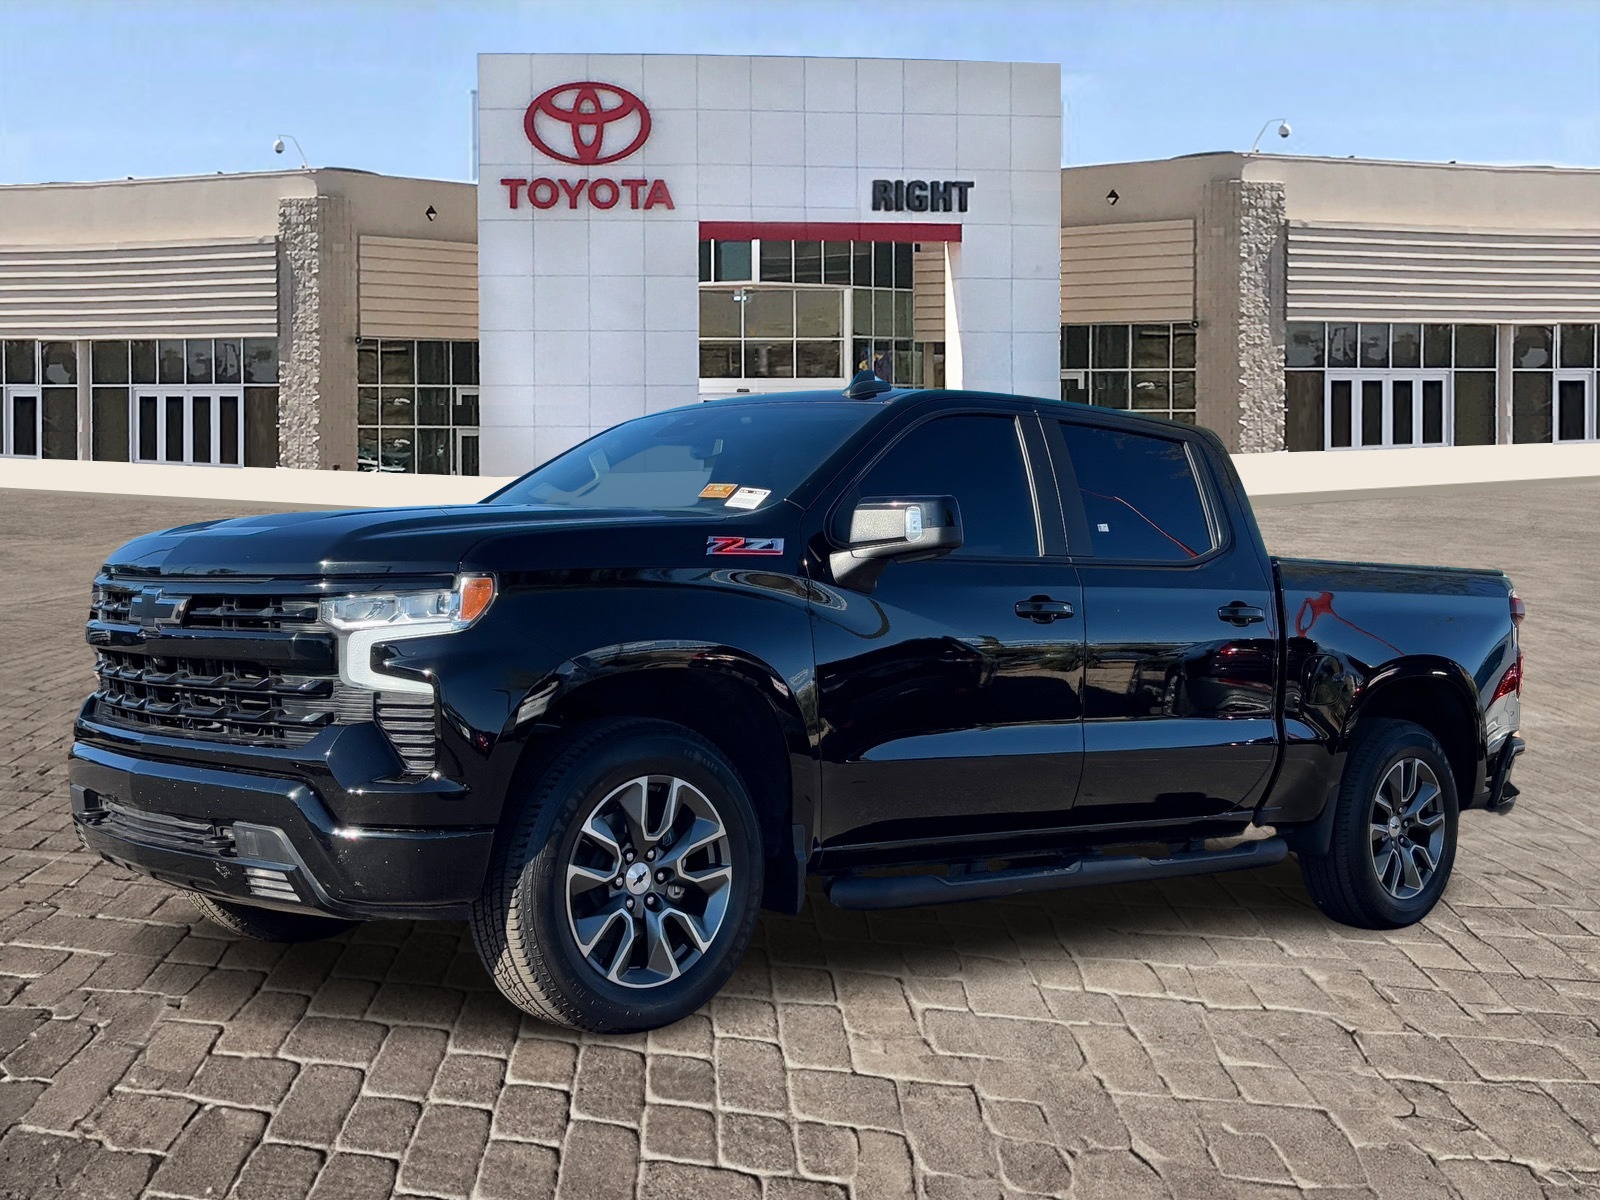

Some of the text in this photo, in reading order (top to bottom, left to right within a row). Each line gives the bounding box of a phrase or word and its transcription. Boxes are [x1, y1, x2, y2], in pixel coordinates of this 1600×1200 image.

[500, 178, 675, 211] TOYOTA
[871, 179, 975, 212] RIGHT
[706, 536, 785, 556] Z71
